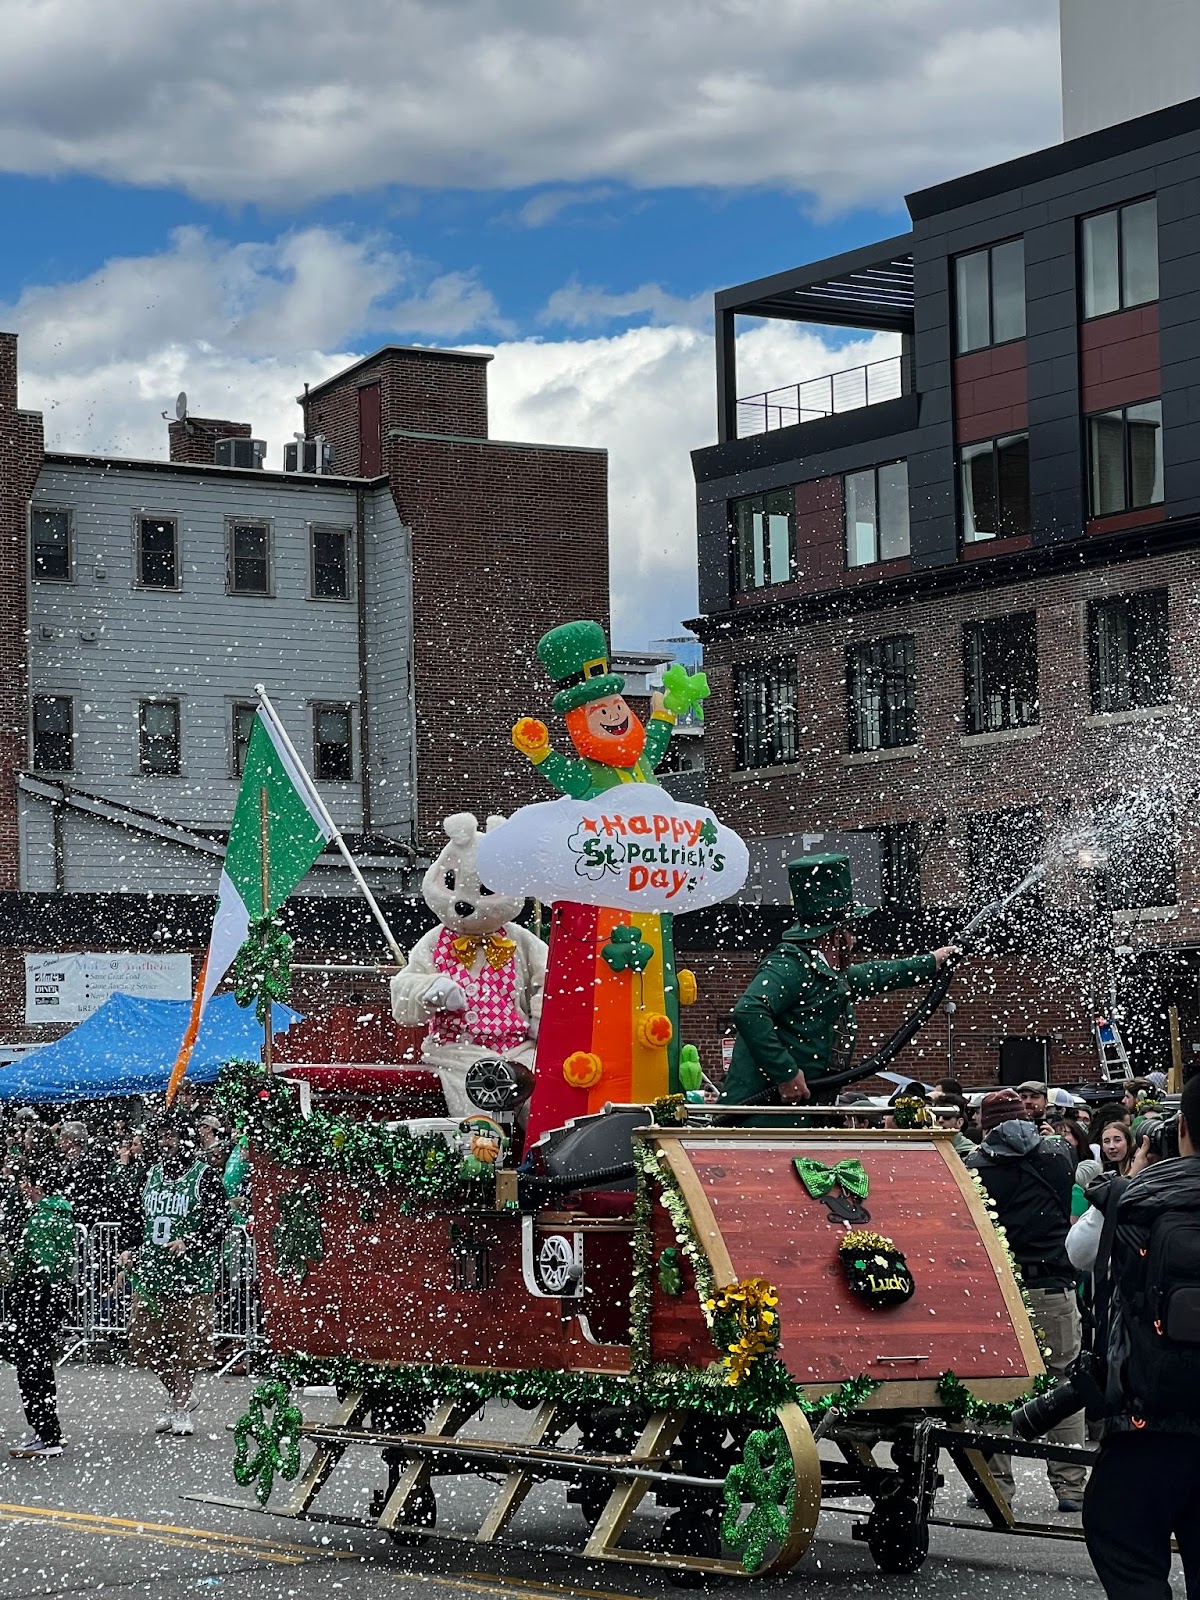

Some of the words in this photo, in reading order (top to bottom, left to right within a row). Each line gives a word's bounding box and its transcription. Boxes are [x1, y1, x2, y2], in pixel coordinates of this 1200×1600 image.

[601, 815, 703, 847] Happy
[627, 842, 726, 872] Patrick's
[628, 865, 689, 899] Day
[109, 959, 119, 970] @
[125, 972, 140, 980] Food
[144, 1190, 190, 1217] BOSTON
[152, 1216, 172, 1245] 0
[868, 1273, 910, 1293] Lucky
